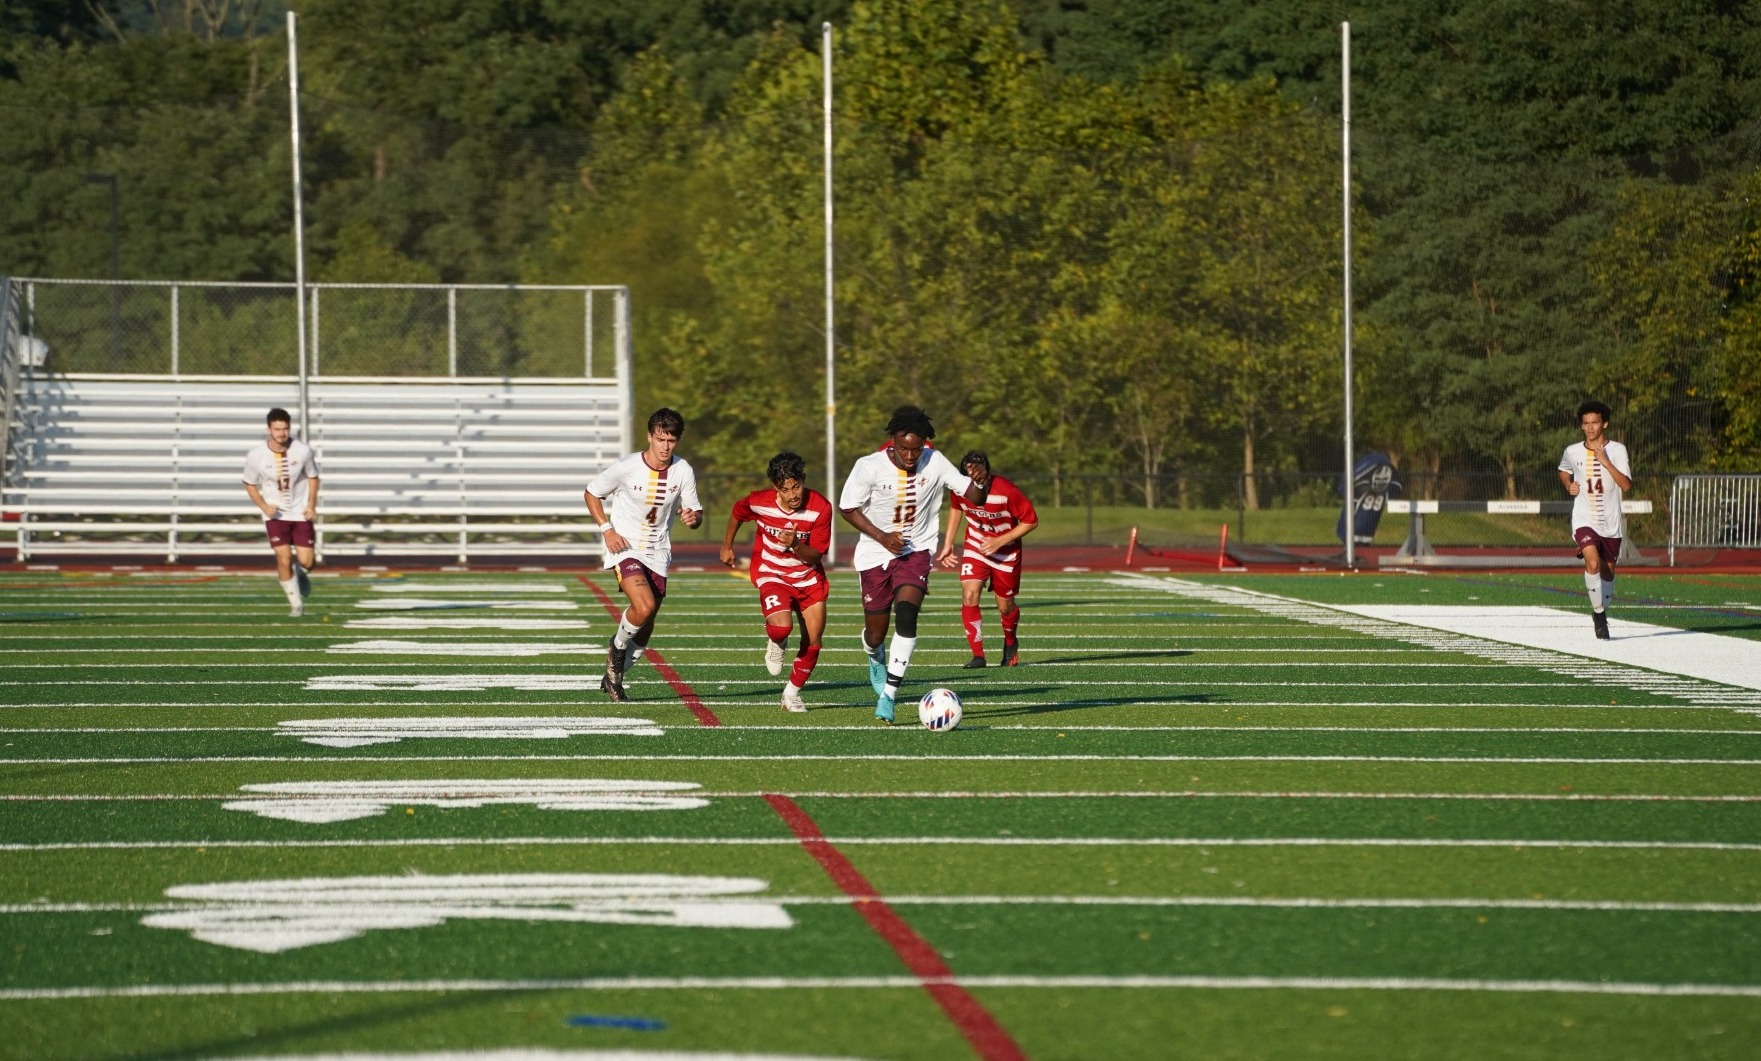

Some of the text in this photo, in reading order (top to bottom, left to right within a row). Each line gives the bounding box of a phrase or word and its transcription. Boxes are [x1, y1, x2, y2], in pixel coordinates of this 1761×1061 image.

[1586, 478, 1604, 494] 14
[1362, 495, 1385, 511] 99
[645, 506, 658, 524] 4
[892, 504, 917, 524] 12
[961, 563, 975, 576] R
[764, 594, 782, 610] R
